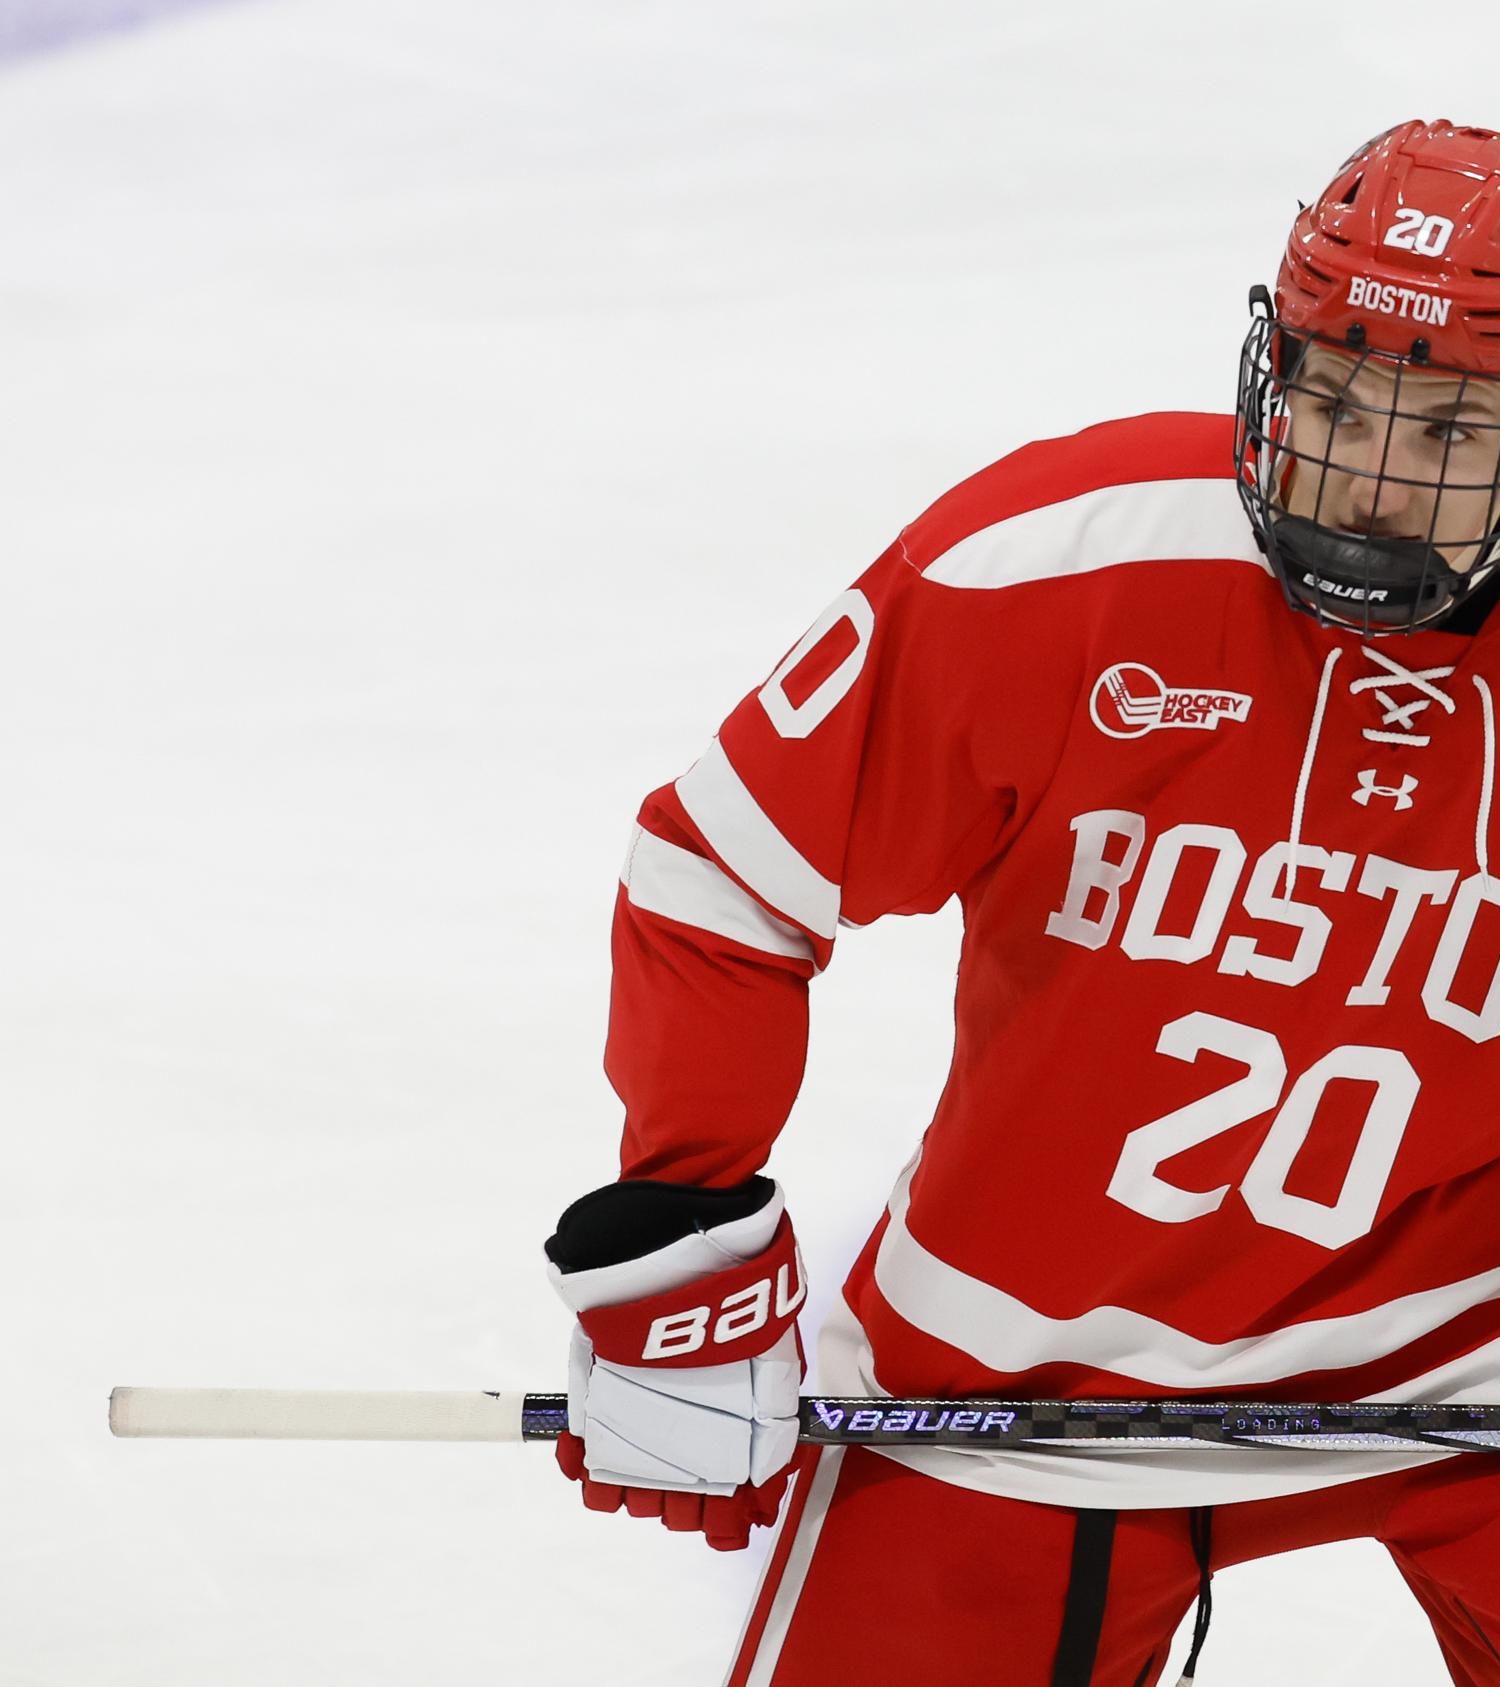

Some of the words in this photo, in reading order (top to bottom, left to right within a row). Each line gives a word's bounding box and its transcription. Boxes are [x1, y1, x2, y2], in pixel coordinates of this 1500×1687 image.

[1383, 207, 1454, 258] 20
[1346, 275, 1453, 327] BOSTON
[1303, 573, 1389, 602] BAUER
[1160, 708, 1212, 724] EAST
[1164, 694, 1242, 713] HOCKEY
[1105, 1011, 1421, 1250] 20
[847, 1409, 1016, 1433] BAUER
